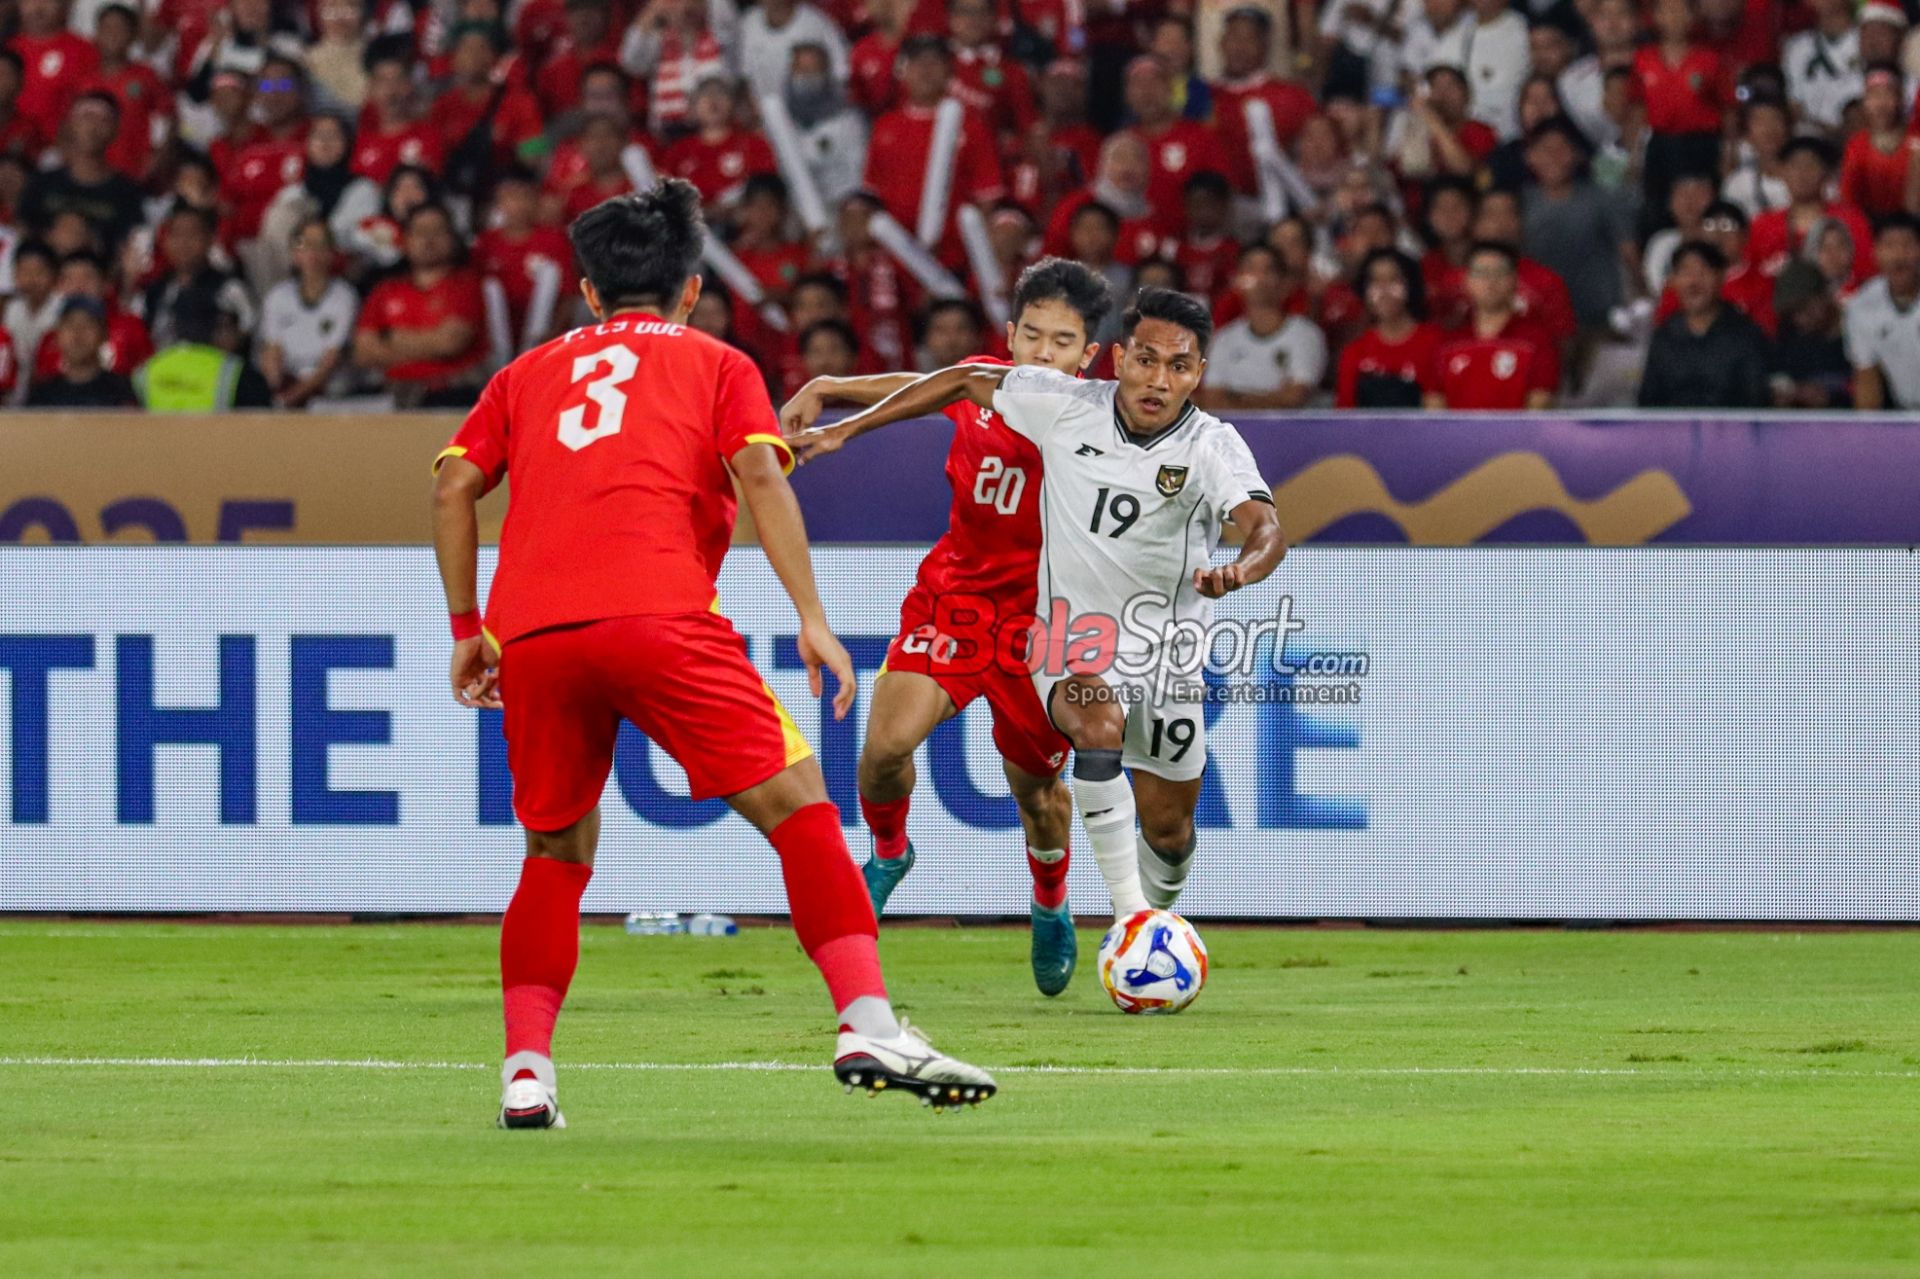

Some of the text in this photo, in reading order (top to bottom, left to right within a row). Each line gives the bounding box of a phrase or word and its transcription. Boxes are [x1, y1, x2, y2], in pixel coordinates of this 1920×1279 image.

[557, 343, 640, 452] 3
[973, 456, 1027, 515] 20
[1090, 487, 1141, 539] 19
[901, 624, 958, 666] 20
[0, 634, 399, 825] THE
[1150, 718, 1196, 763] 19
